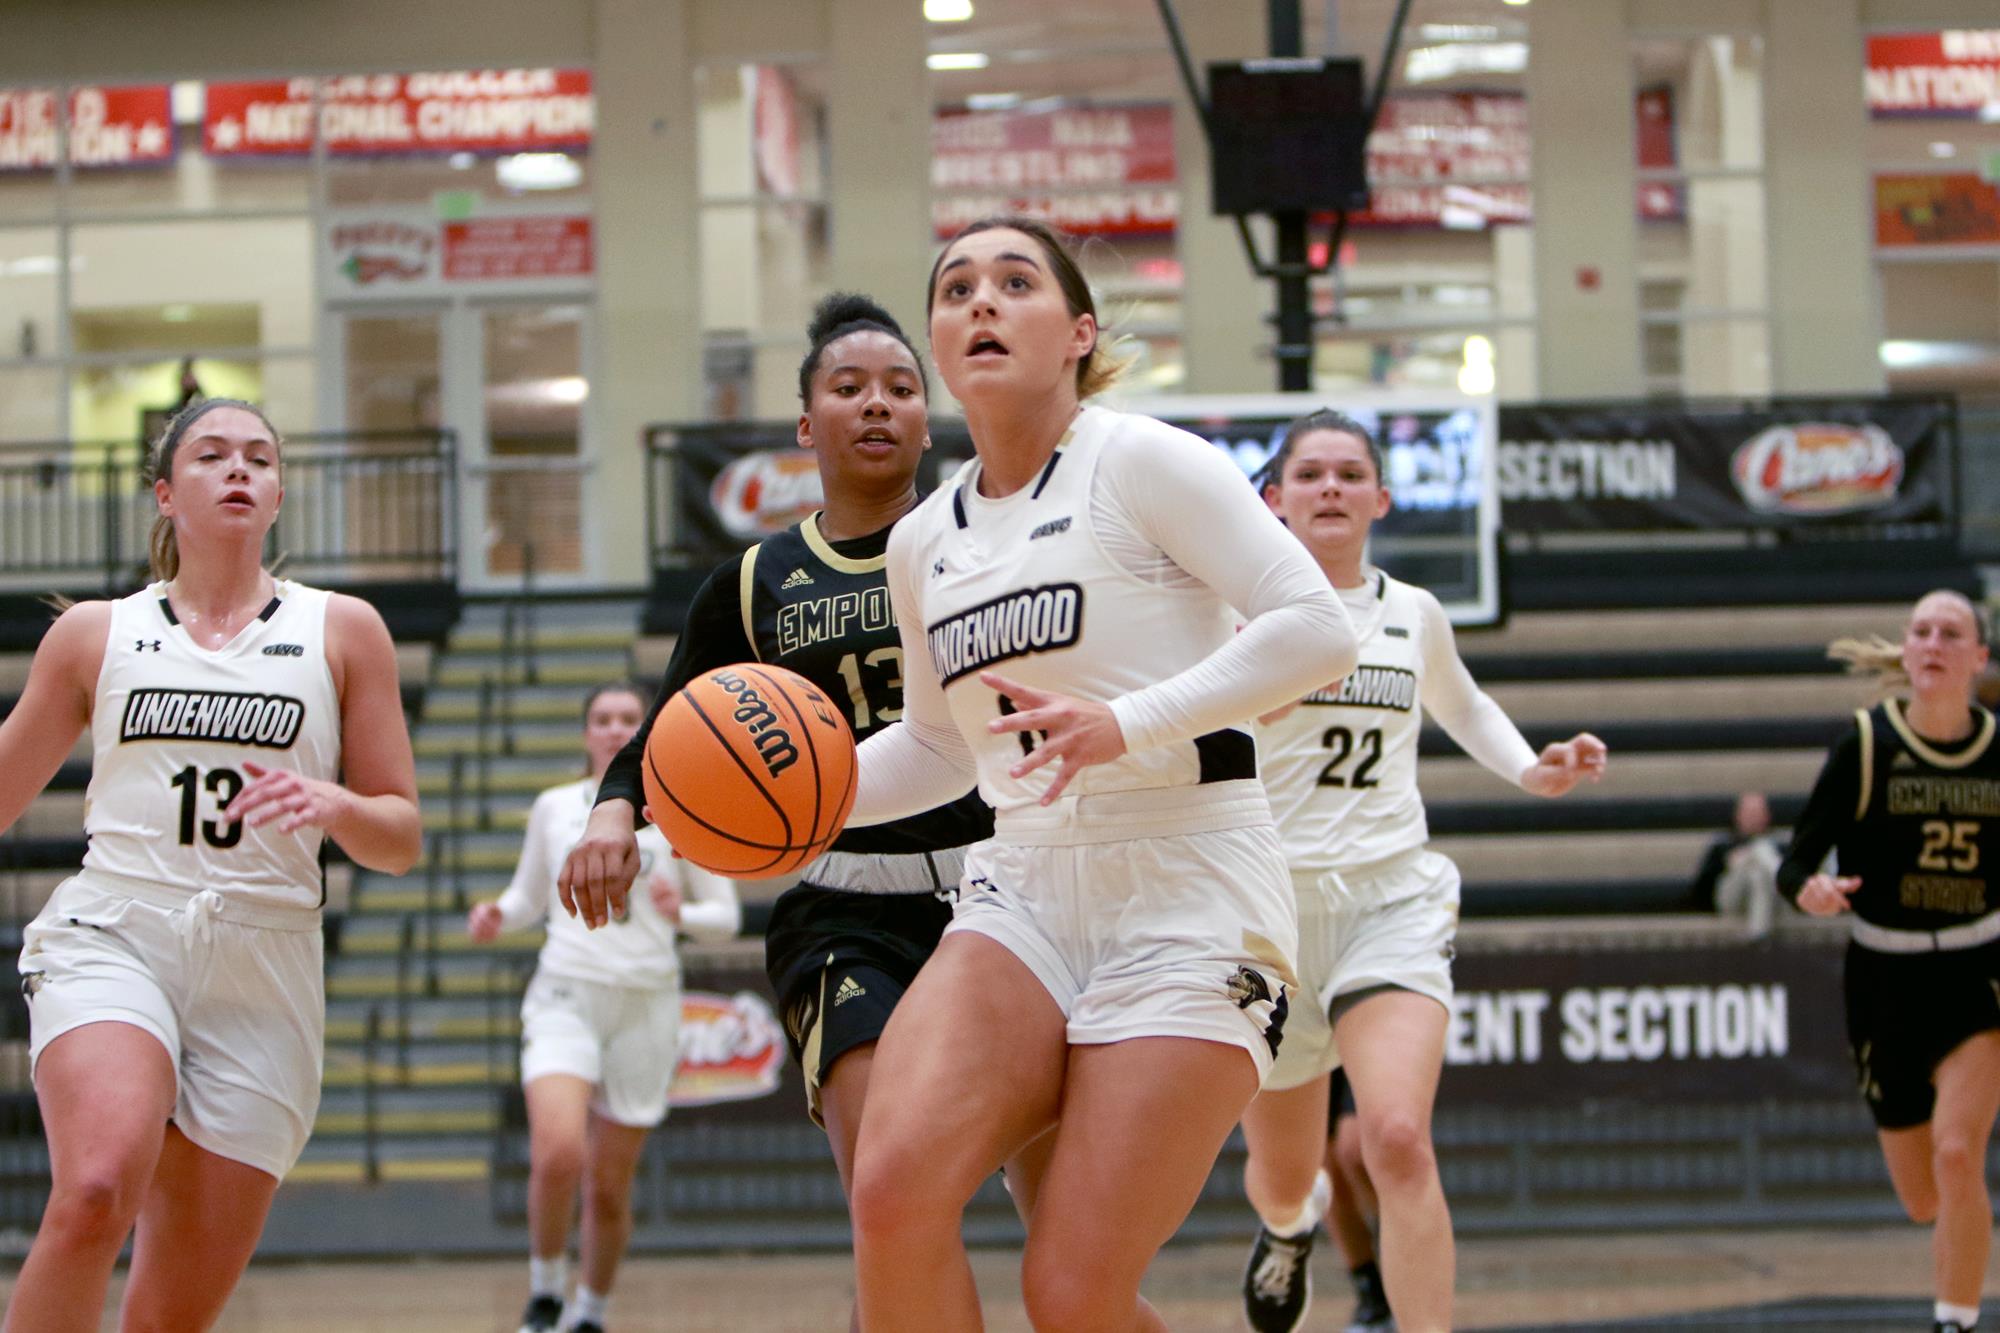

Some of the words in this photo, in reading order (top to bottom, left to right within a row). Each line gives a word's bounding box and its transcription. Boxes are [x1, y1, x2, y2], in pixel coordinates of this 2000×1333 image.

[245, 100, 411, 144] NATONAL
[1500, 440, 1677, 498] SECTION
[781, 578, 815, 590] adidas
[777, 586, 899, 656] EMPO
[837, 646, 904, 729] 13
[124, 693, 301, 746] LINDENWOOD
[710, 671, 799, 779] Wilson
[1317, 726, 1383, 788] 22
[171, 765, 243, 849] 13
[1918, 819, 1981, 872] 25
[834, 987, 867, 1007] adidas
[1559, 983, 1789, 1062] SECTION
